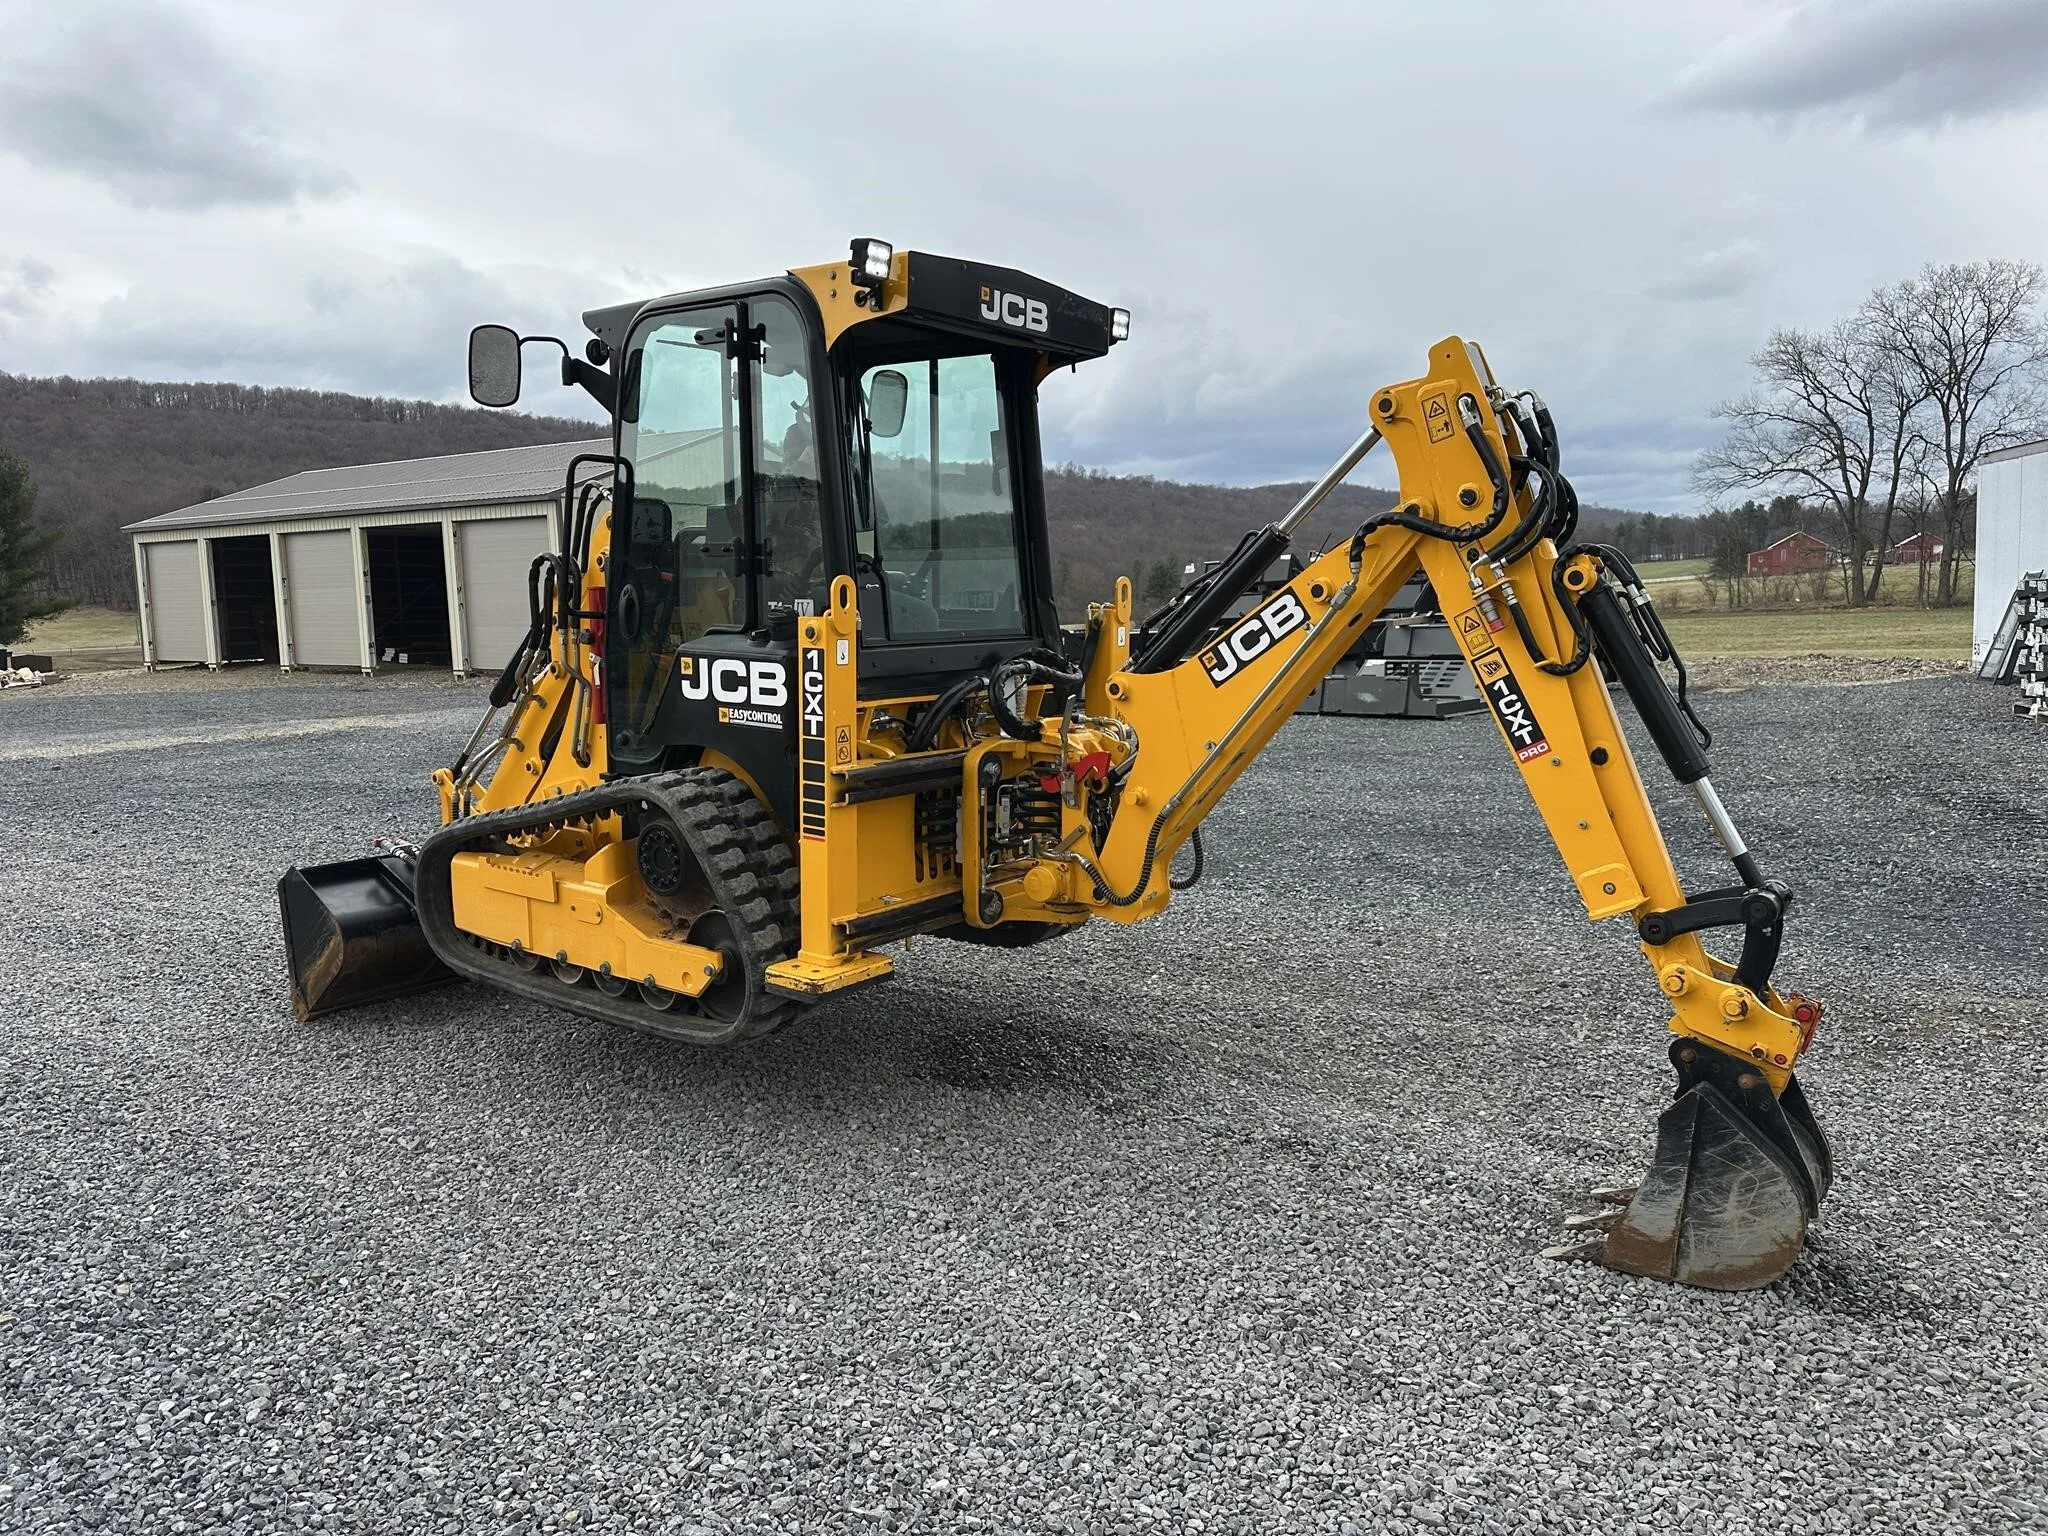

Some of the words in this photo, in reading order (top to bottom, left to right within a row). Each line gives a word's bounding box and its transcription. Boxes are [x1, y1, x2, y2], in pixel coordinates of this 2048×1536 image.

[981, 289, 1048, 333] JCB
[1210, 594, 1305, 682] JCB
[681, 658, 788, 707] JCB
[1483, 660, 1502, 676] JCB
[804, 650, 824, 735] 1CXT
[1493, 679, 1533, 745] 1CXT
[729, 708, 783, 725] EASYCONTROL
[1519, 742, 1549, 761] PRO
